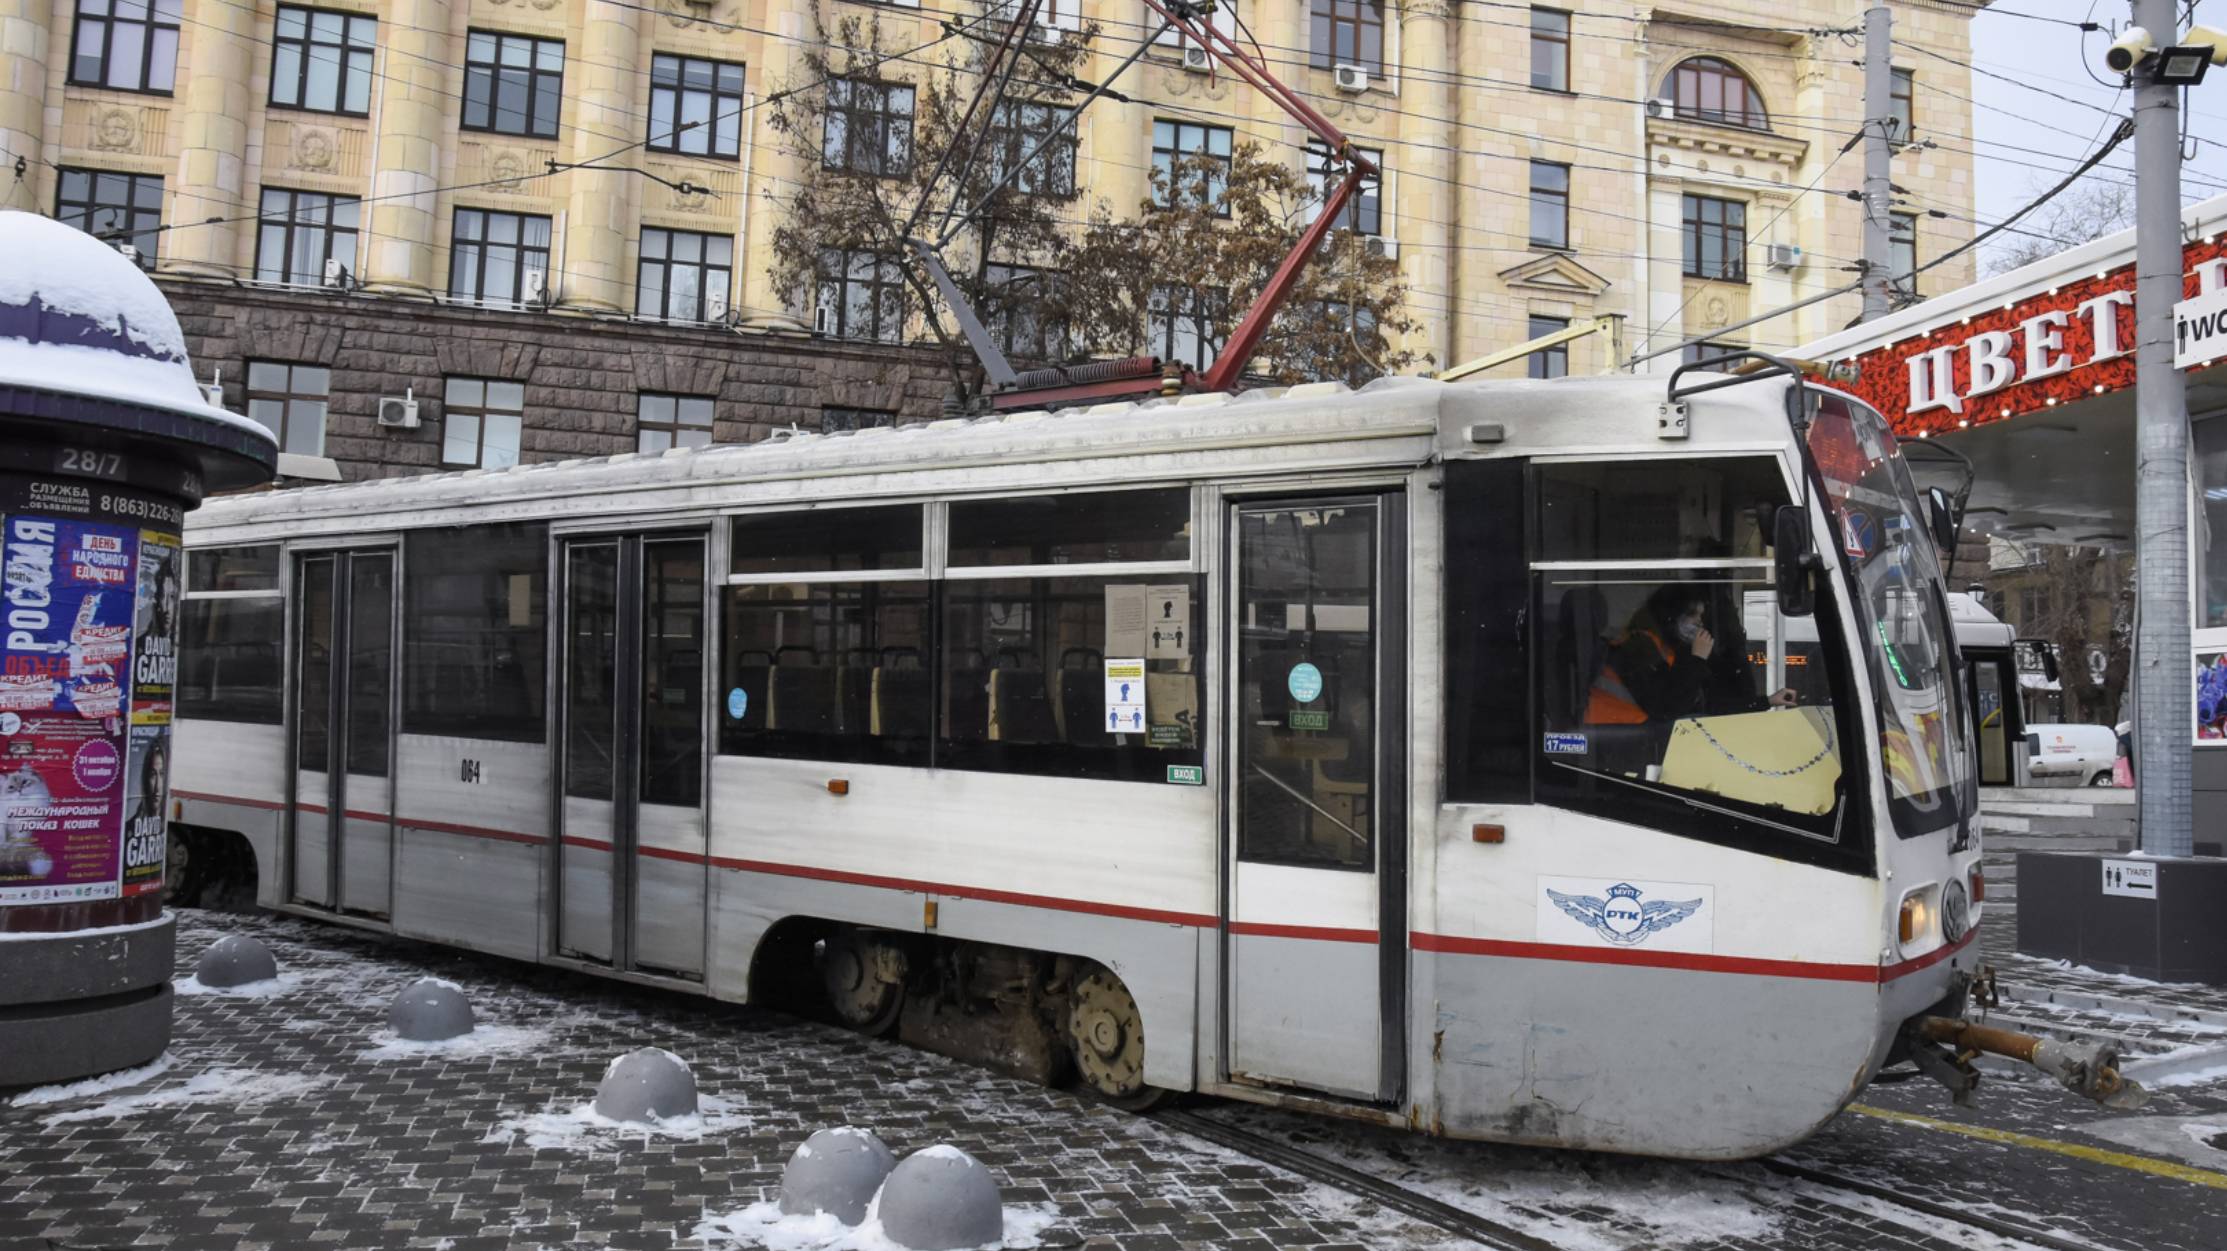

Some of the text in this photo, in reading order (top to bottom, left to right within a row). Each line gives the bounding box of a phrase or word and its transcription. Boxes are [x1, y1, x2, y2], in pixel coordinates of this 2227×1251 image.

[30, 482, 90, 498] СЛУЖБА
[100, 495, 112, 511] 8
[113, 496, 149, 519] (863)
[91, 536, 116, 550] ДЕНЬ
[145, 636, 171, 656] DAVID
[1294, 714, 1323, 727] ВХОД
[1546, 740, 1560, 751] 17
[461, 758, 480, 785] 064
[1173, 767, 1196, 781] ВХОД
[63, 819, 100, 830] КОШЕК
[134, 816, 161, 838] DAVID
